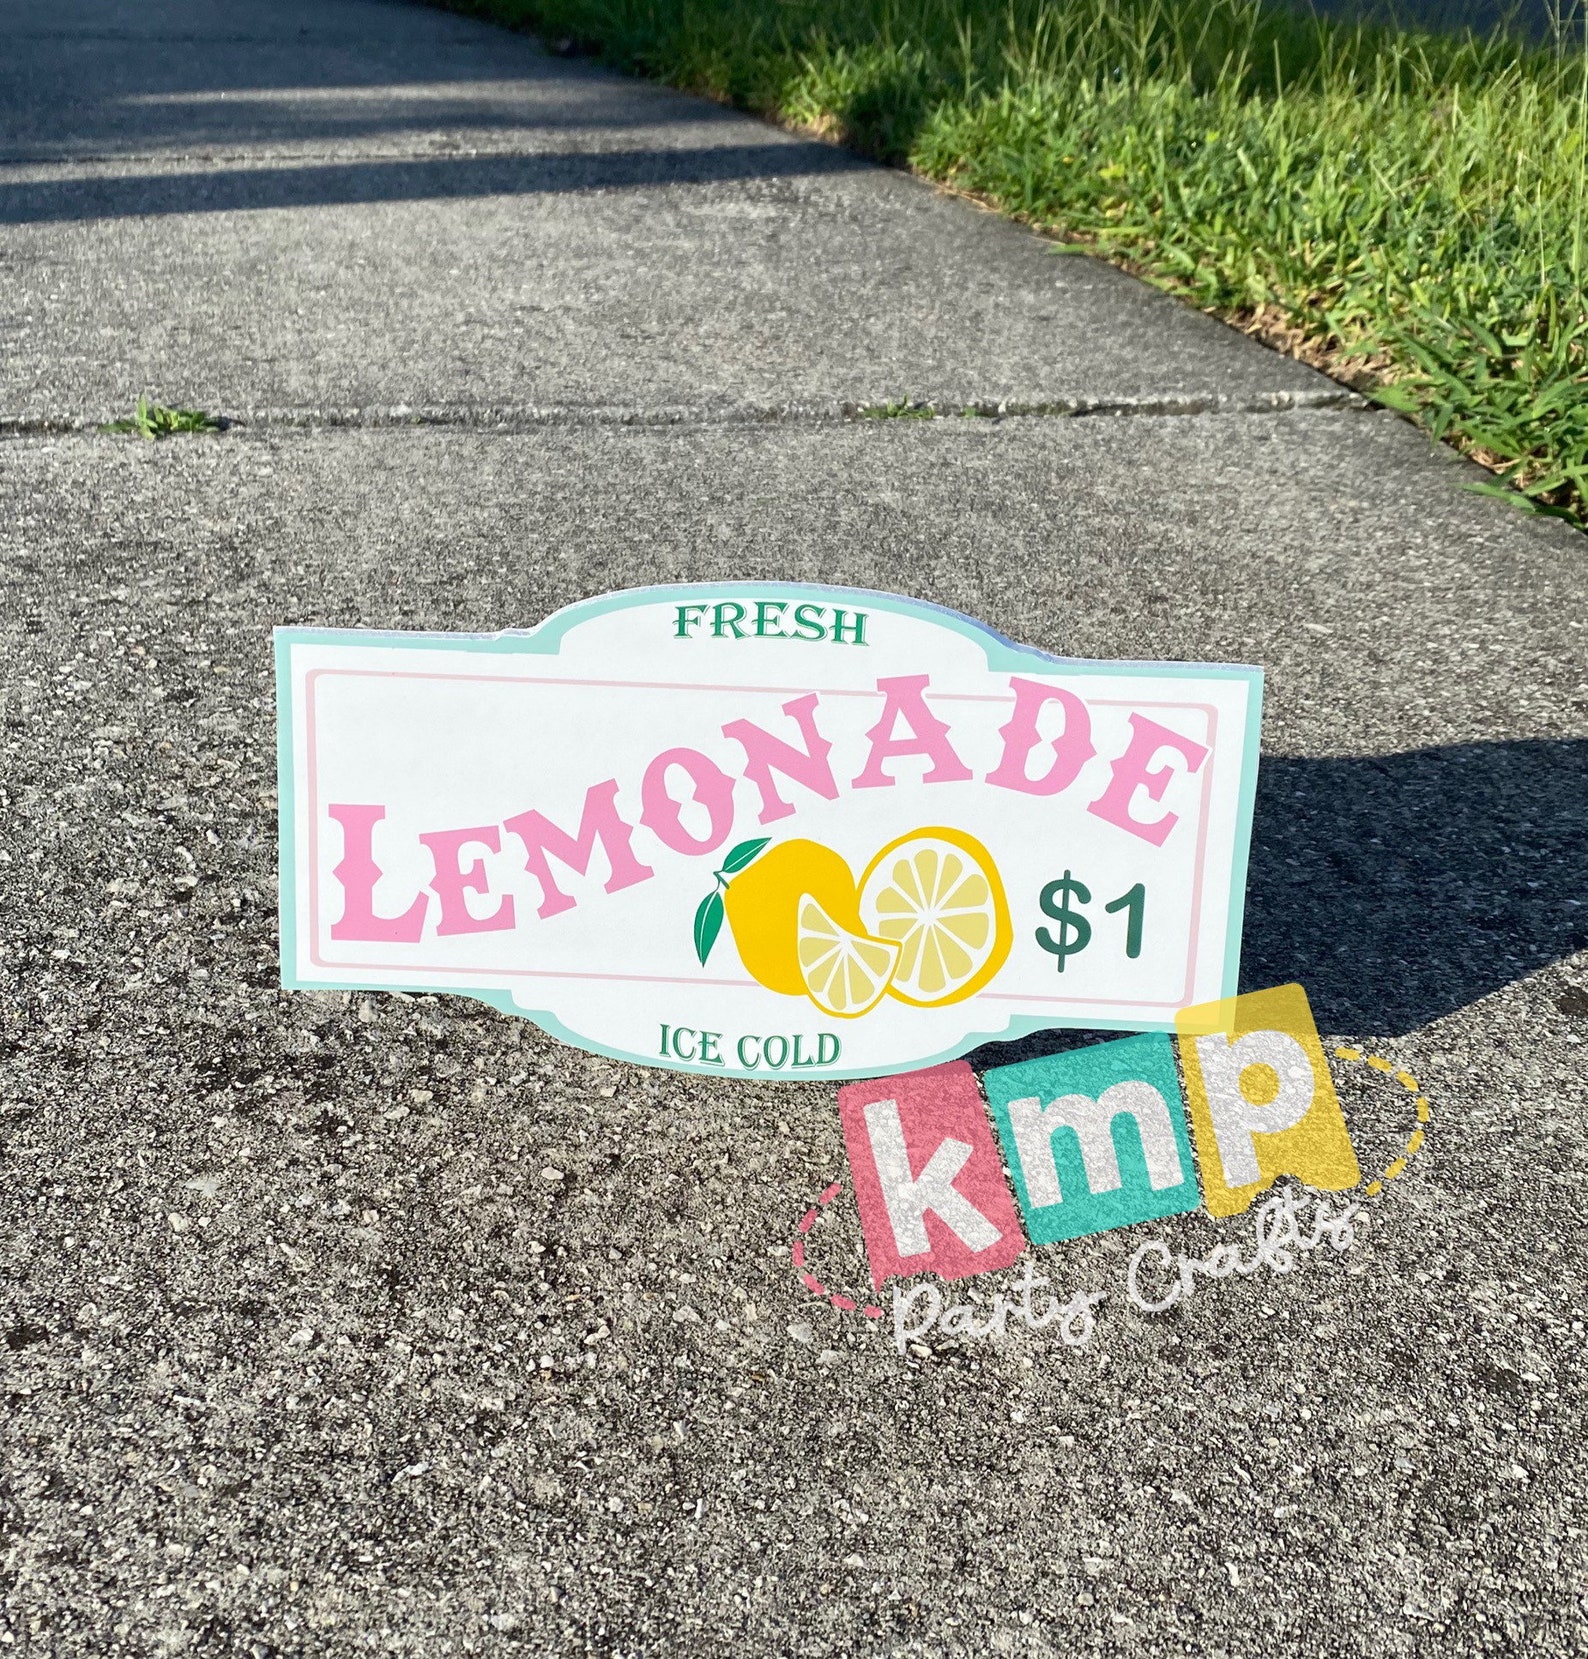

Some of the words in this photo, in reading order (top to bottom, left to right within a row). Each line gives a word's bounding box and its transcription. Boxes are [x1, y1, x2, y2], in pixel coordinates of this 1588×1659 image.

[673, 601, 870, 646] FRESH
[329, 674, 1208, 944] LEMONADE
[1035, 870, 1147, 972] $1
[659, 1023, 724, 1065] ICE
[736, 1030, 841, 1070] COLD
